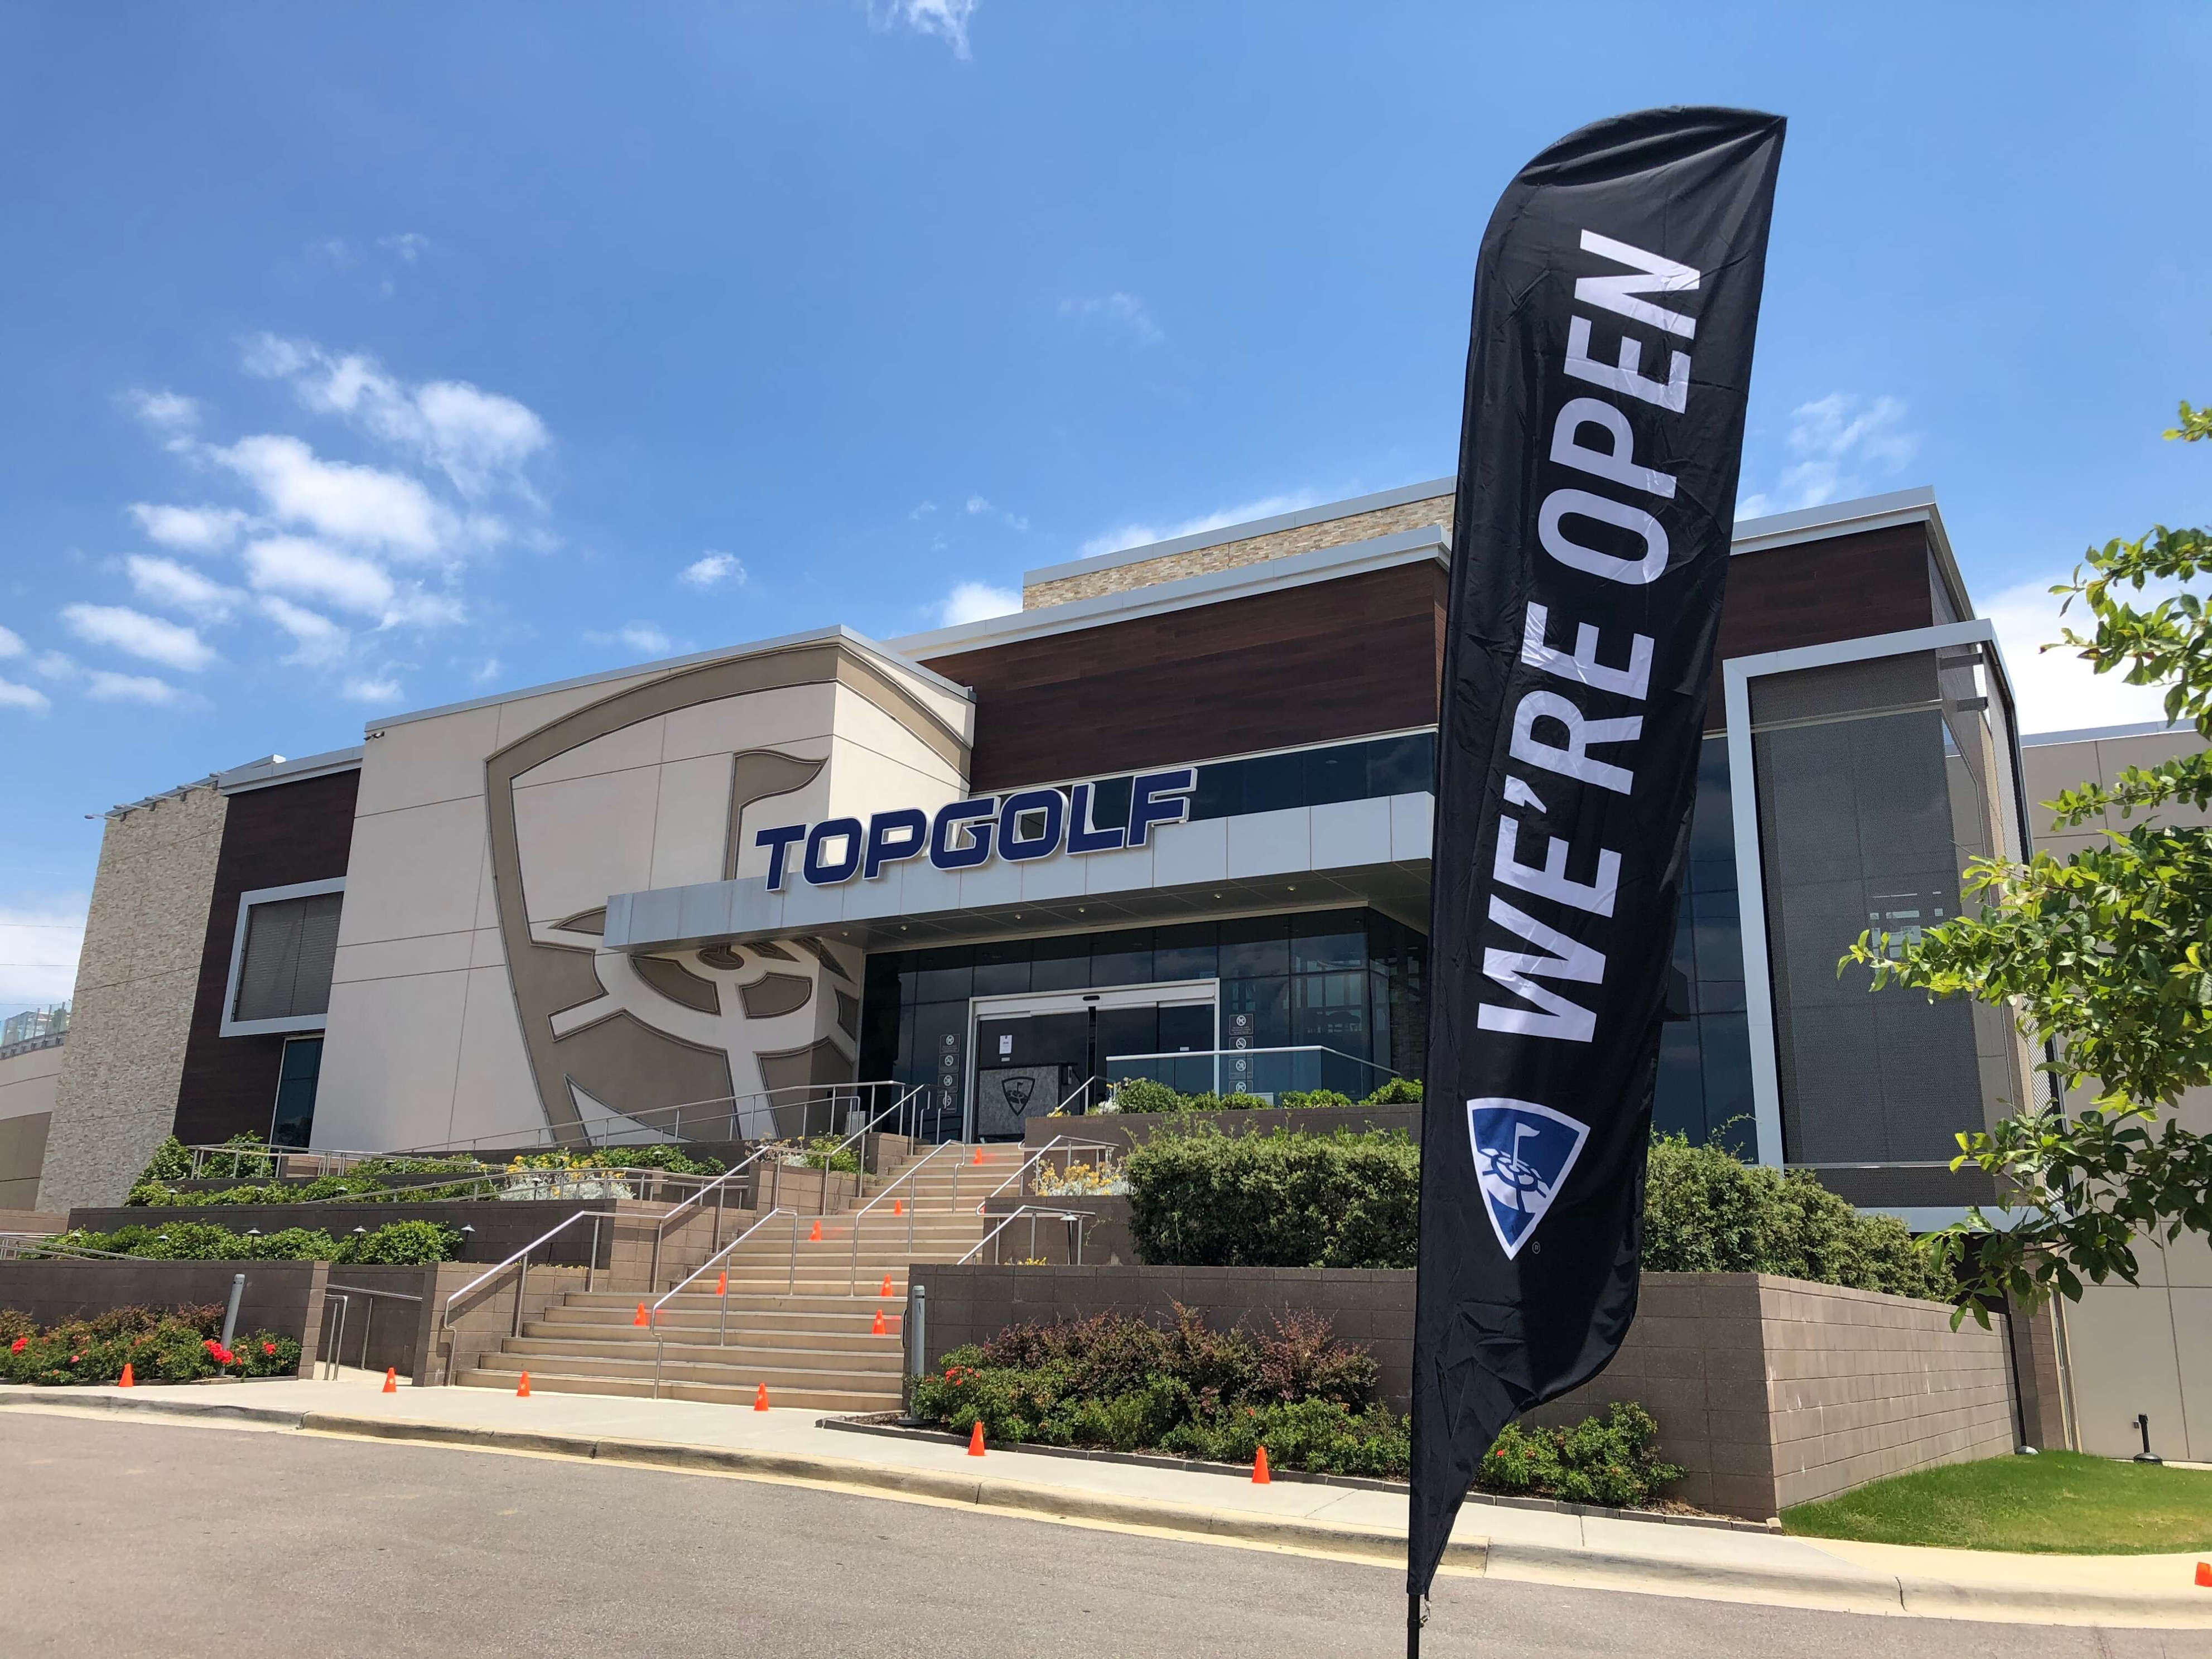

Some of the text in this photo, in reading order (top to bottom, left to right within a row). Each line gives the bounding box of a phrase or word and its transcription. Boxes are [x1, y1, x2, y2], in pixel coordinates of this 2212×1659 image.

[755, 768, 1197, 891] TOPGOLF
[1477, 229, 1700, 1043] WE'RE OPEN
